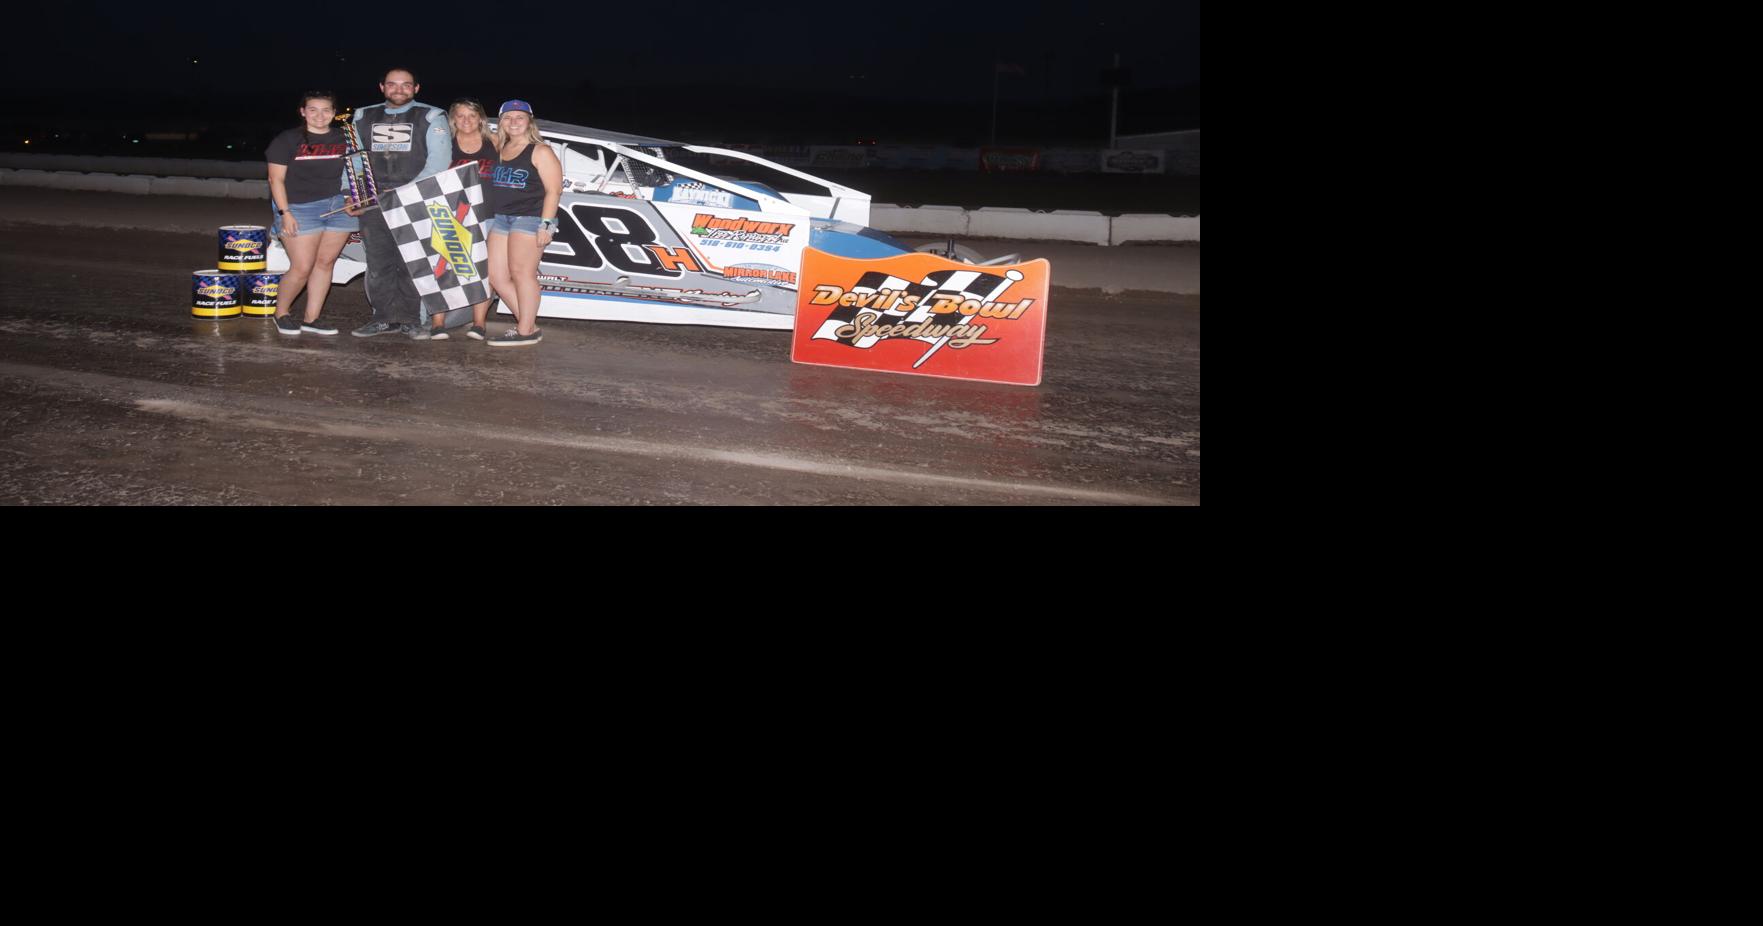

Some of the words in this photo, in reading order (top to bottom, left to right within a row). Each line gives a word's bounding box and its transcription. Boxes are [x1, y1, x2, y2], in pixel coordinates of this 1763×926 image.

[372, 124, 411, 143] S
[430, 207, 473, 274] SUNOCO
[651, 247, 703, 272] H
[724, 266, 768, 279] MIRROR
[768, 270, 796, 284] LAKE
[809, 284, 923, 312] Devil's
[930, 293, 1036, 320] Bowl
[835, 312, 1000, 348] Speedway
